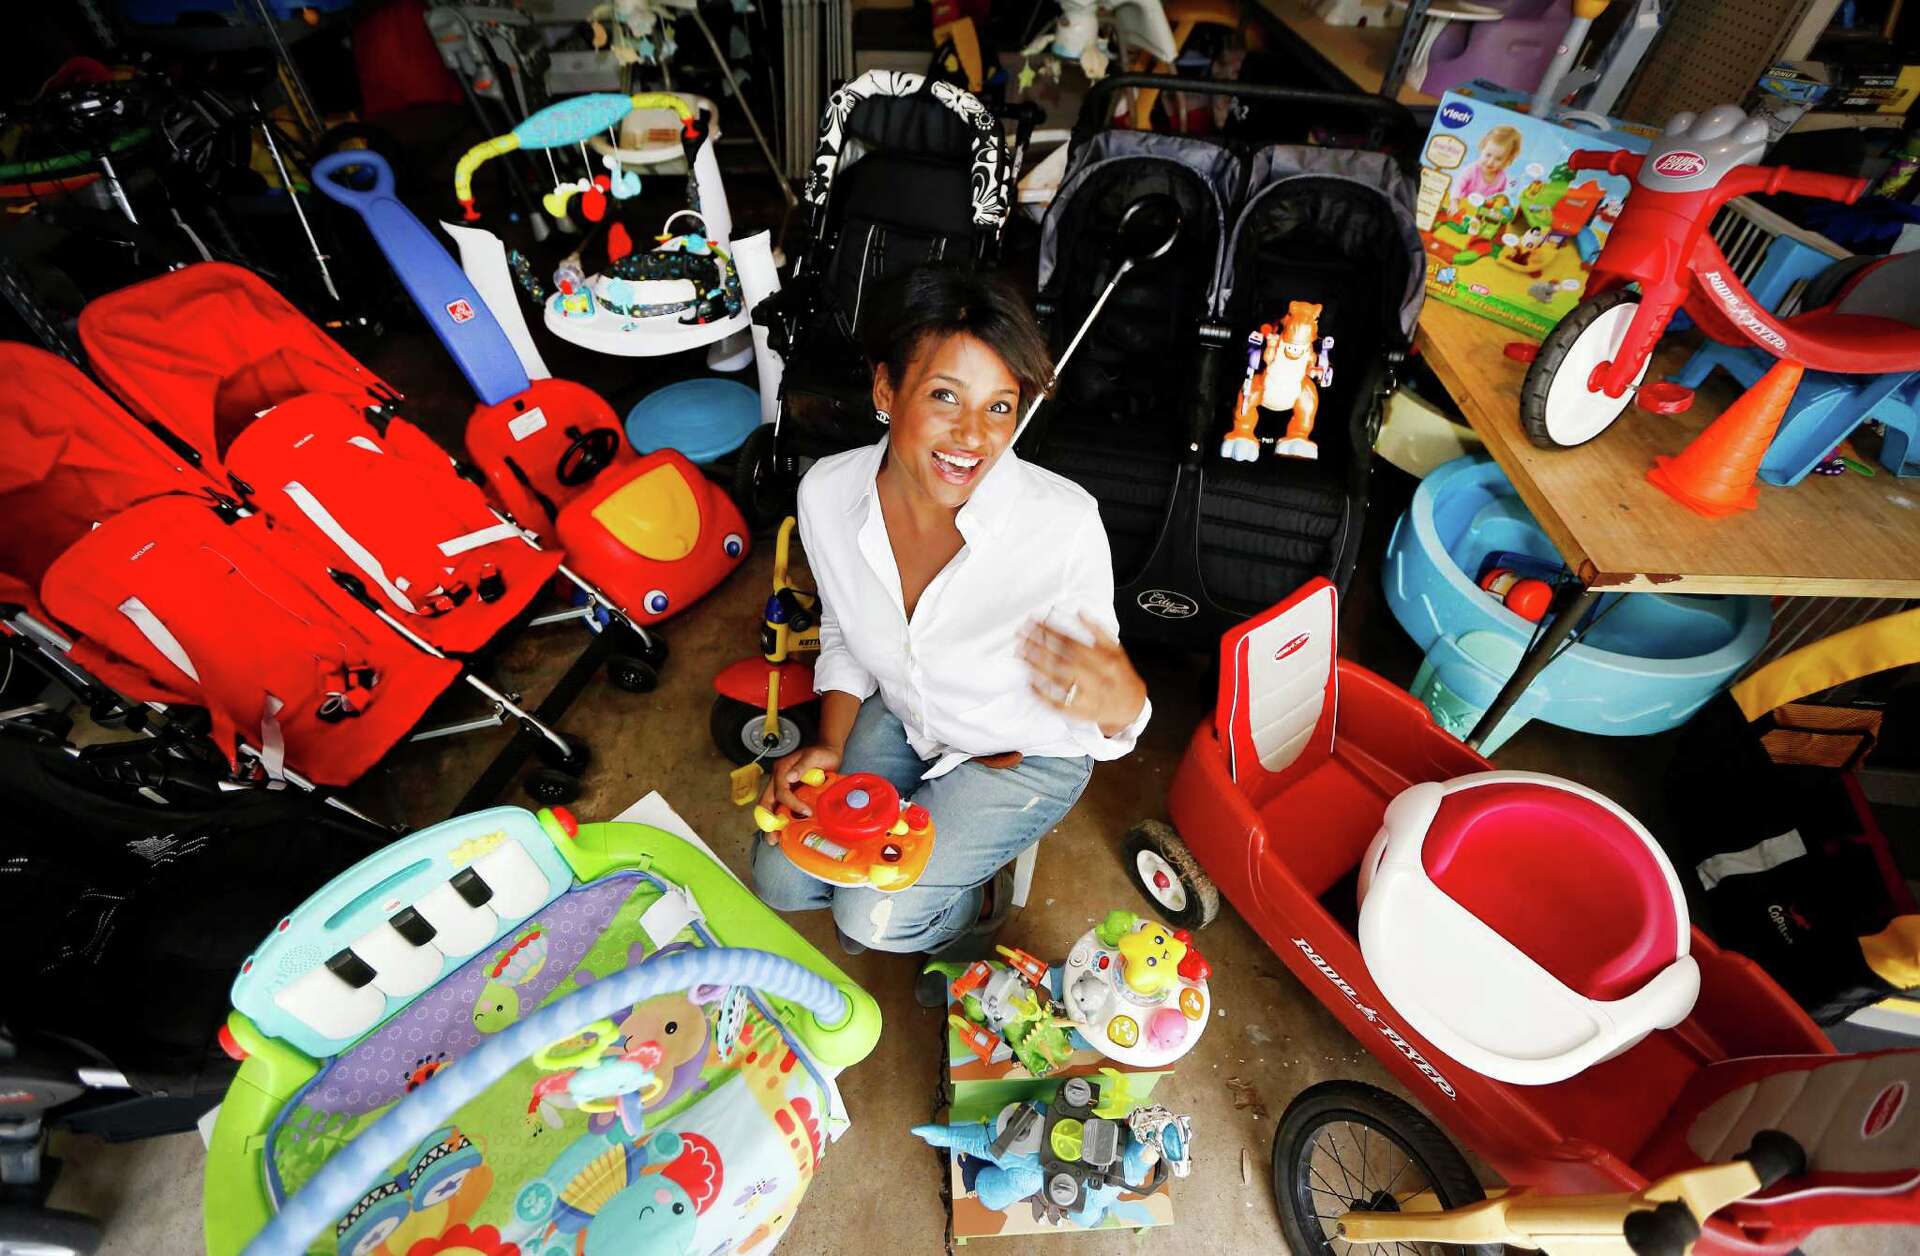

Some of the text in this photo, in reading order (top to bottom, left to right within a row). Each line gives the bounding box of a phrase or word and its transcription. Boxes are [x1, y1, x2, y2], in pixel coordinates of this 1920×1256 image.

[1705, 271, 1787, 352] RADIO FLYER
[1291, 938, 1457, 1100] RADIO FLYER
